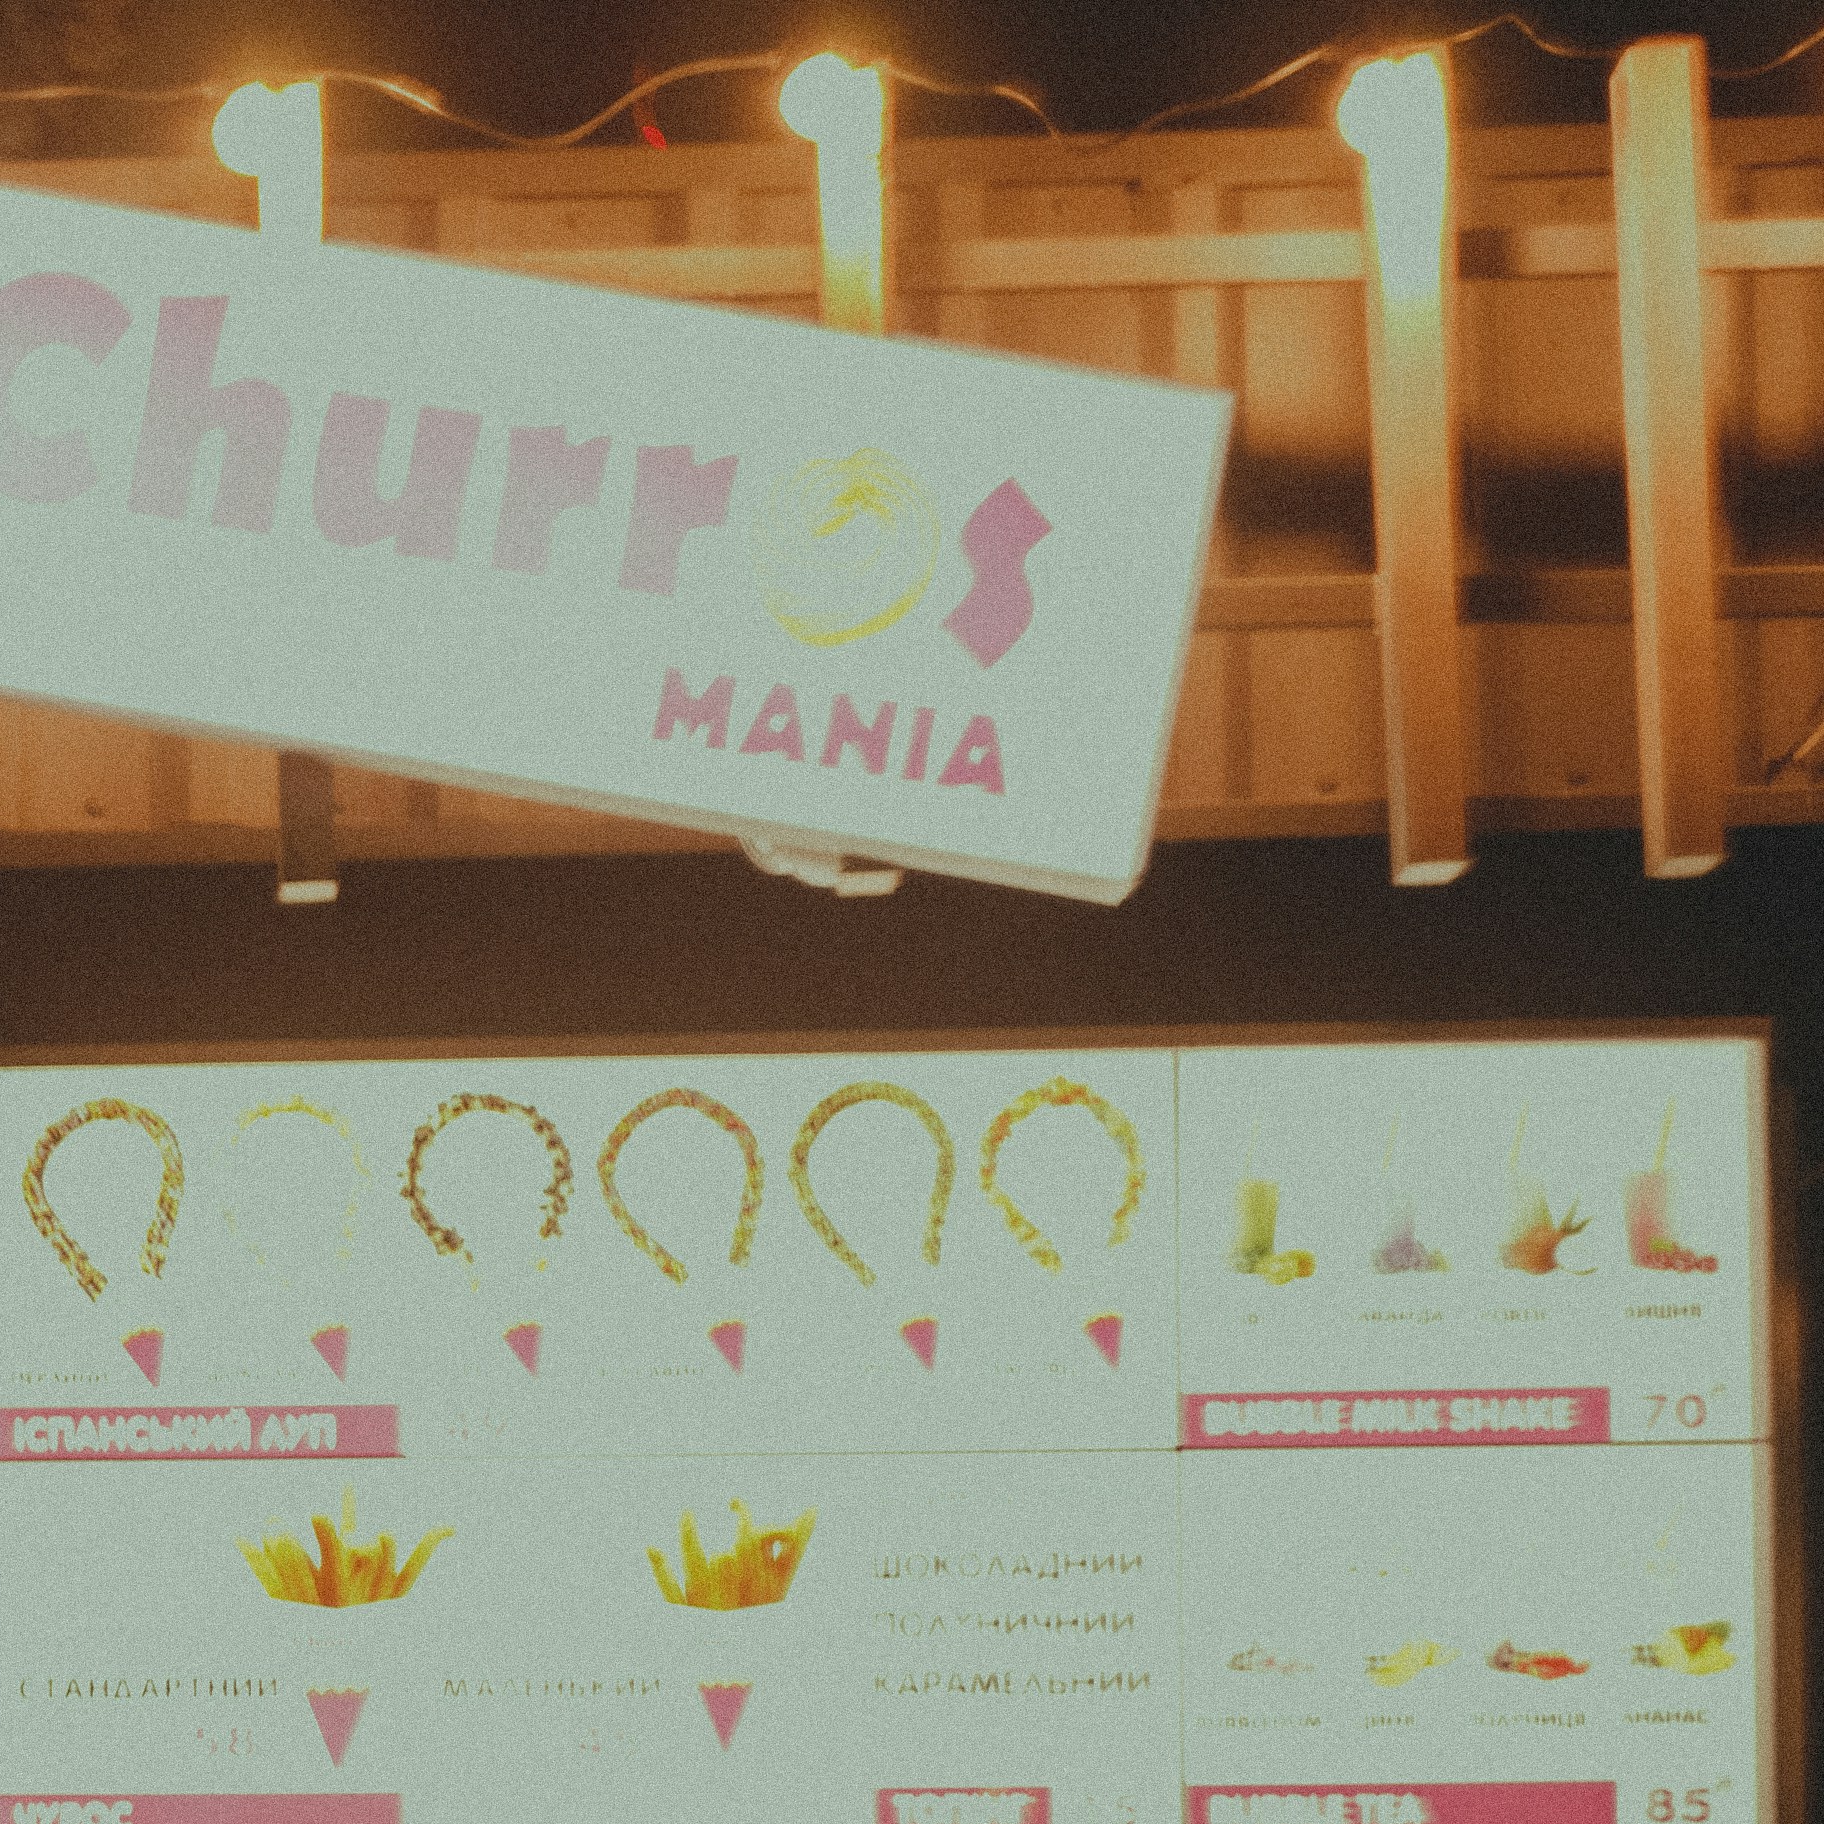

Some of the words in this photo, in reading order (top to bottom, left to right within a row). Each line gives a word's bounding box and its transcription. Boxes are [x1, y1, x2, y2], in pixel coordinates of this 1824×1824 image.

[652, 666, 1007, 796] MANIA
[1645, 1393, 1707, 1430] 70
[1645, 1786, 1712, 1824] 85
